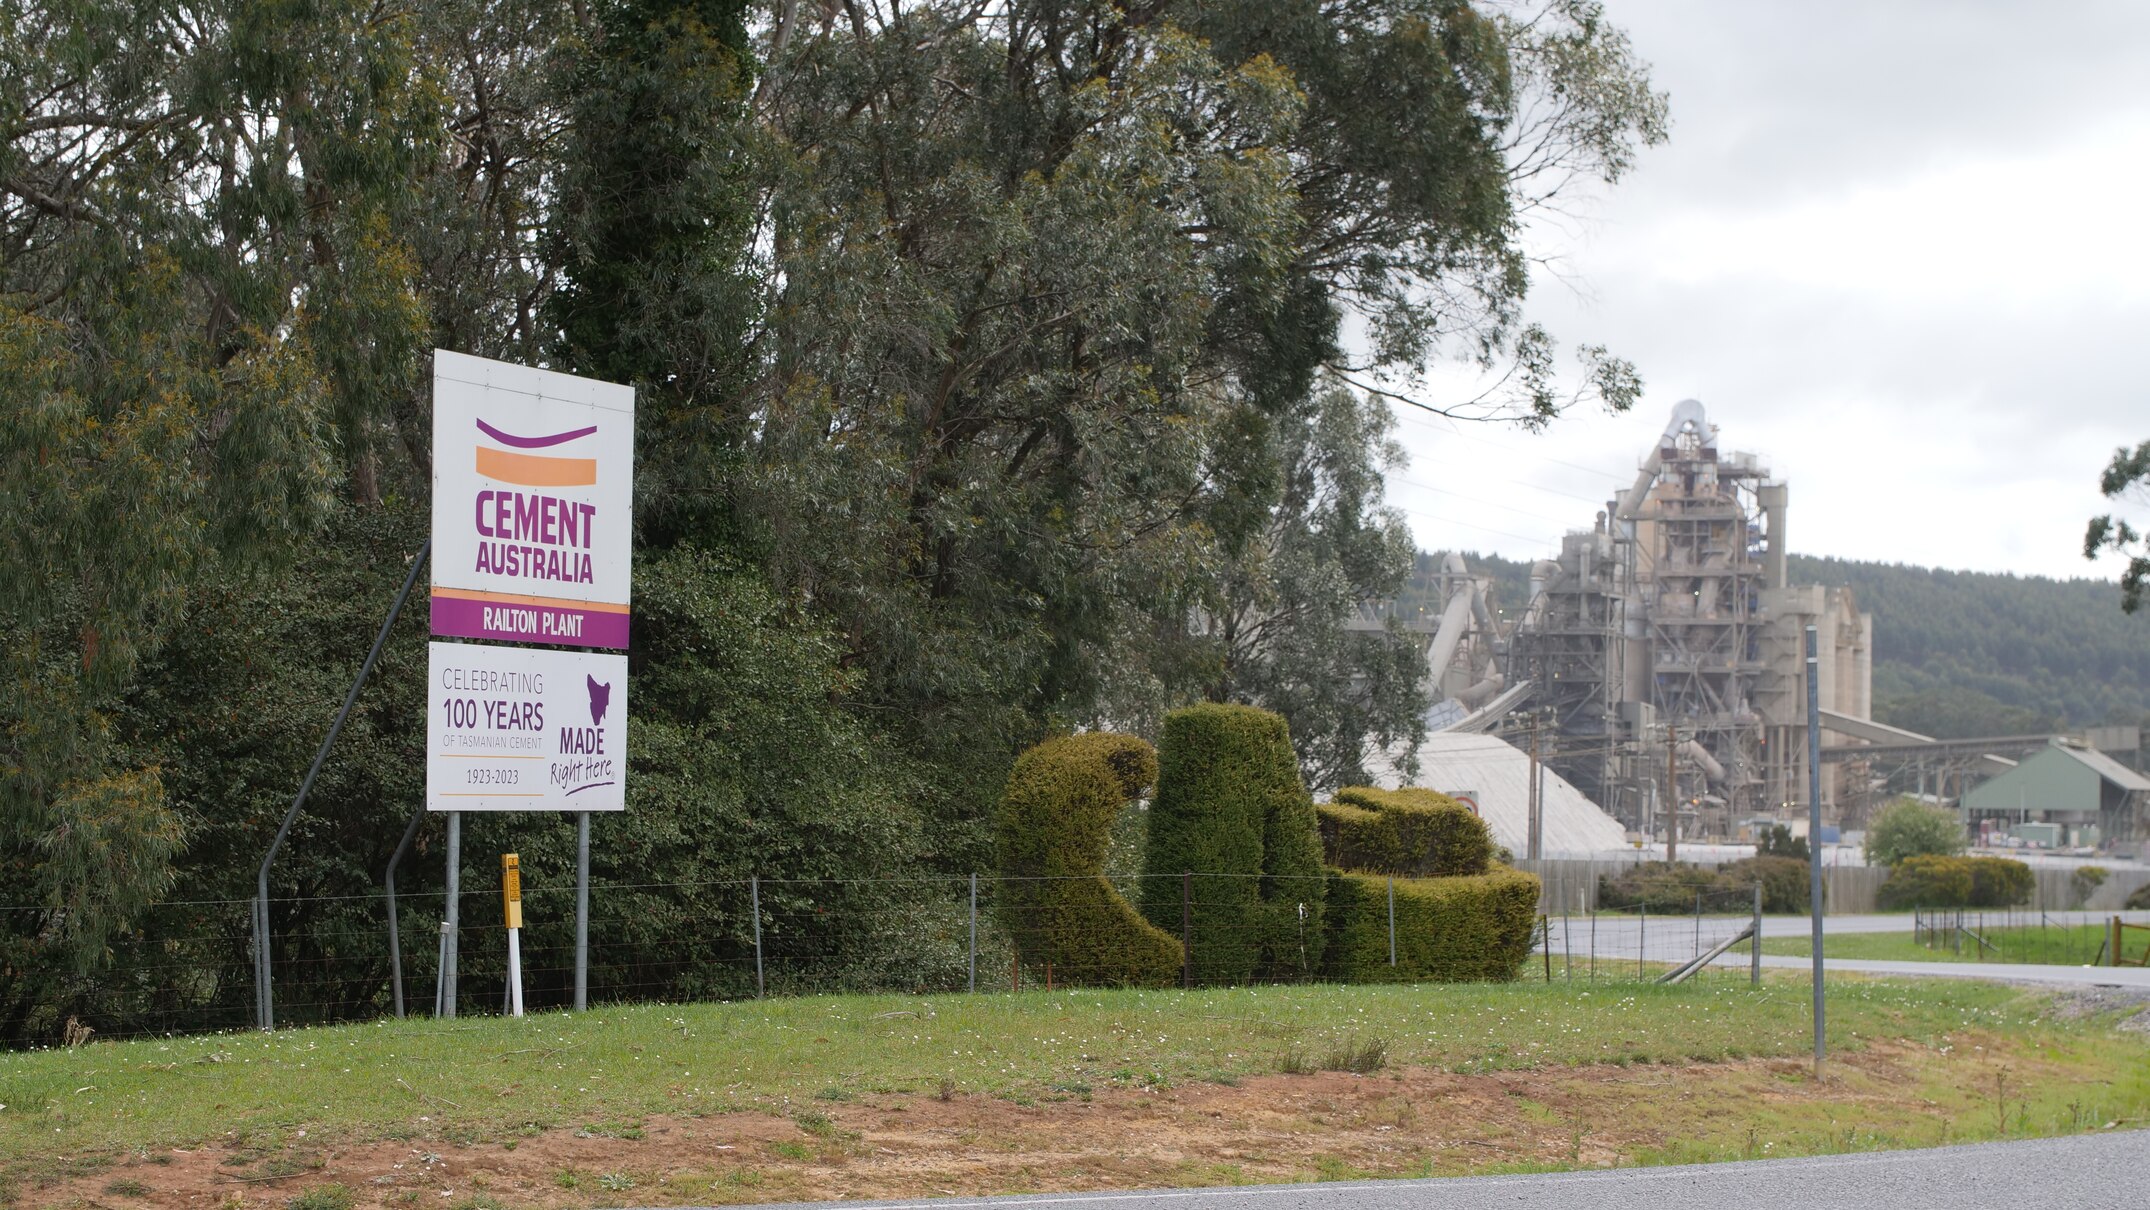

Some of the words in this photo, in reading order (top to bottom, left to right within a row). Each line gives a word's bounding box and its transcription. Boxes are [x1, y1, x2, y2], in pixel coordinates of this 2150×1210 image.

[476, 491, 596, 549] CEMENT
[476, 541, 594, 584] AUSTRALIA
[483, 607, 537, 633] RAILTON
[543, 611, 584, 637] PLANT
[442, 668, 543, 694] CELEBRATING
[443, 698, 477, 728] 100
[483, 700, 544, 731] YEARS
[443, 734, 455, 747] OF
[458, 735, 507, 748] TASMANIAN
[509, 736, 543, 749] CEMENT
[560, 727, 604, 754] MADE
[467, 769, 519, 784] 1923-2023
[550, 758, 583, 789] Right
[586, 756, 612, 780] Here
